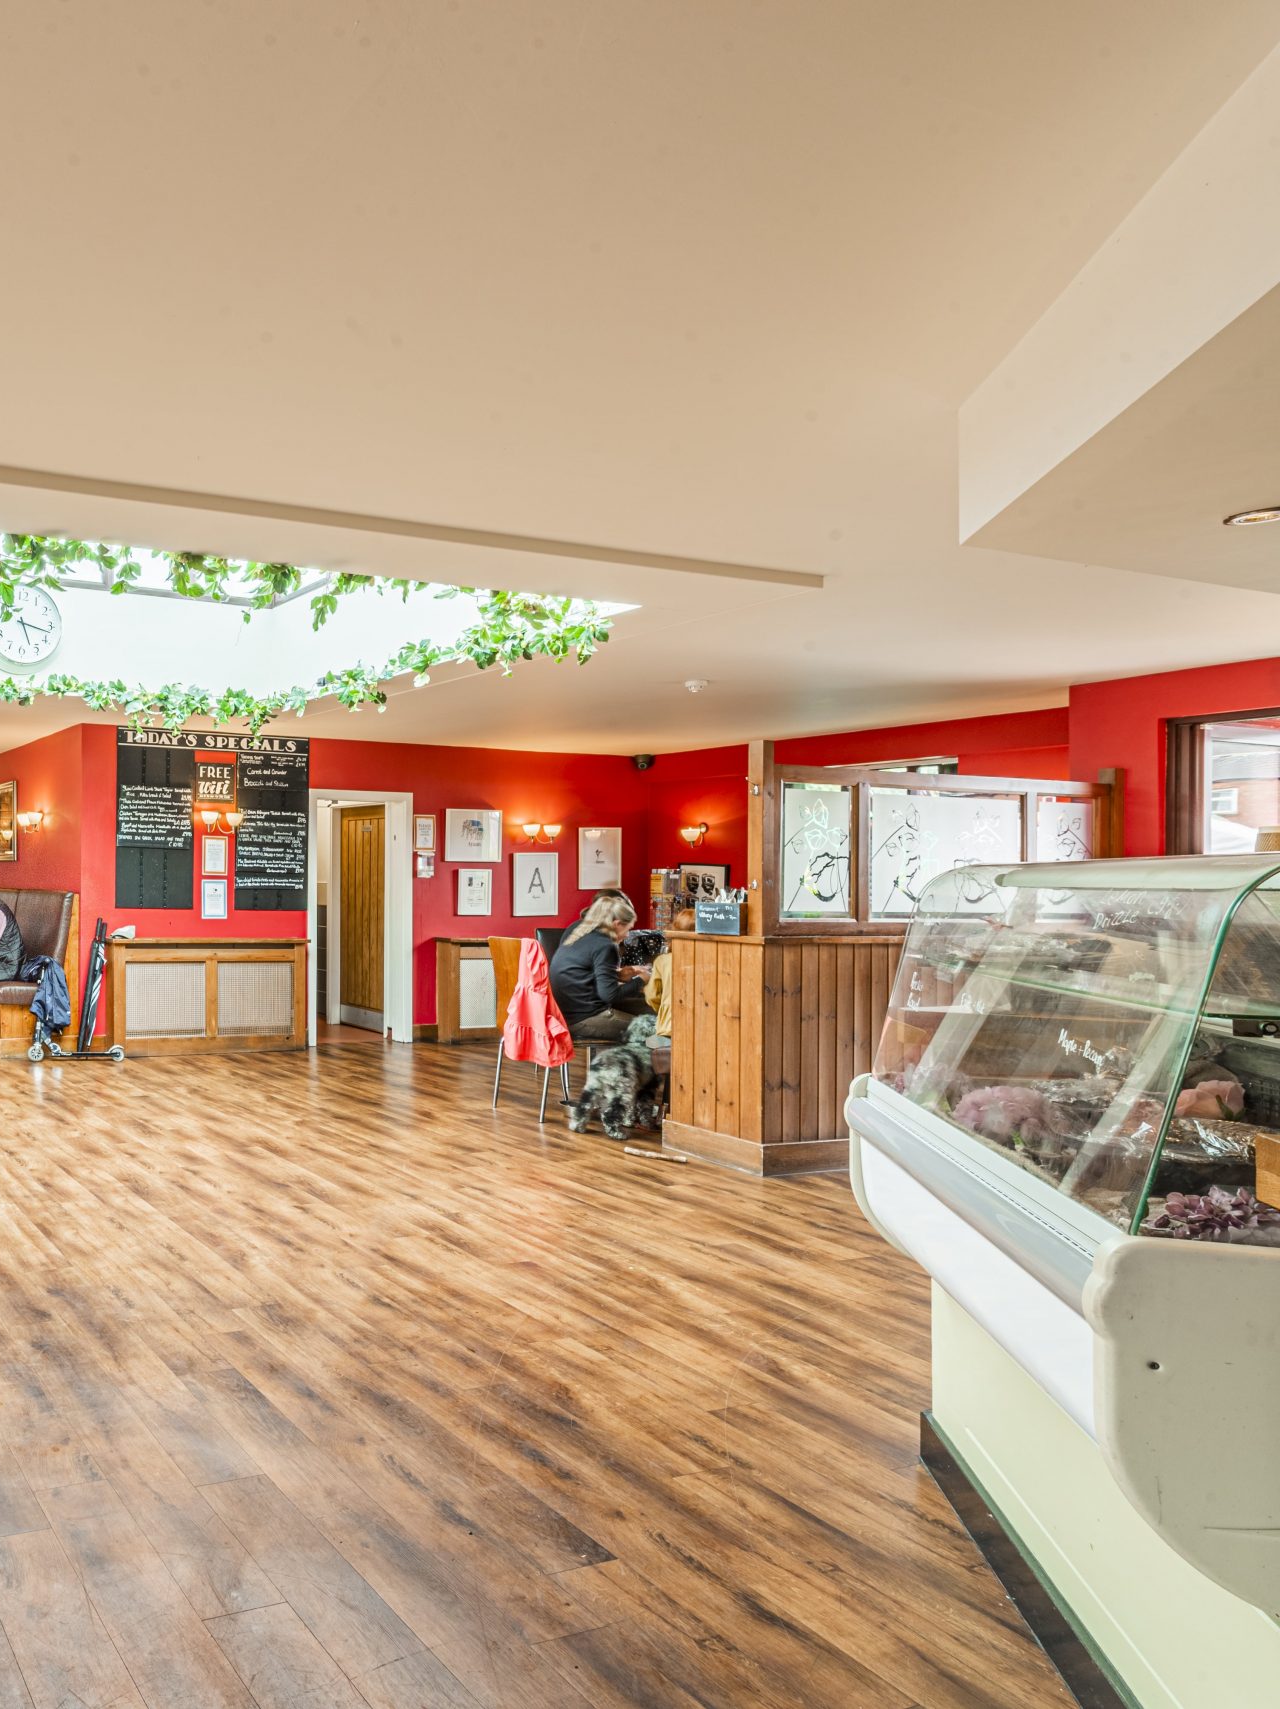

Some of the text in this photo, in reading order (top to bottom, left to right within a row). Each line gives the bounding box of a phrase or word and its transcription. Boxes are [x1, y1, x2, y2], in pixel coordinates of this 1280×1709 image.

[18, 590, 30, 602] 12
[41, 606, 48, 616] 2
[47, 620, 54, 631] 3
[41, 634, 49, 644] 4
[7, 640, 14, 650] 7
[18, 644, 26, 655] 6
[33, 643, 40, 655] 5
[199, 766, 231, 779] FREE
